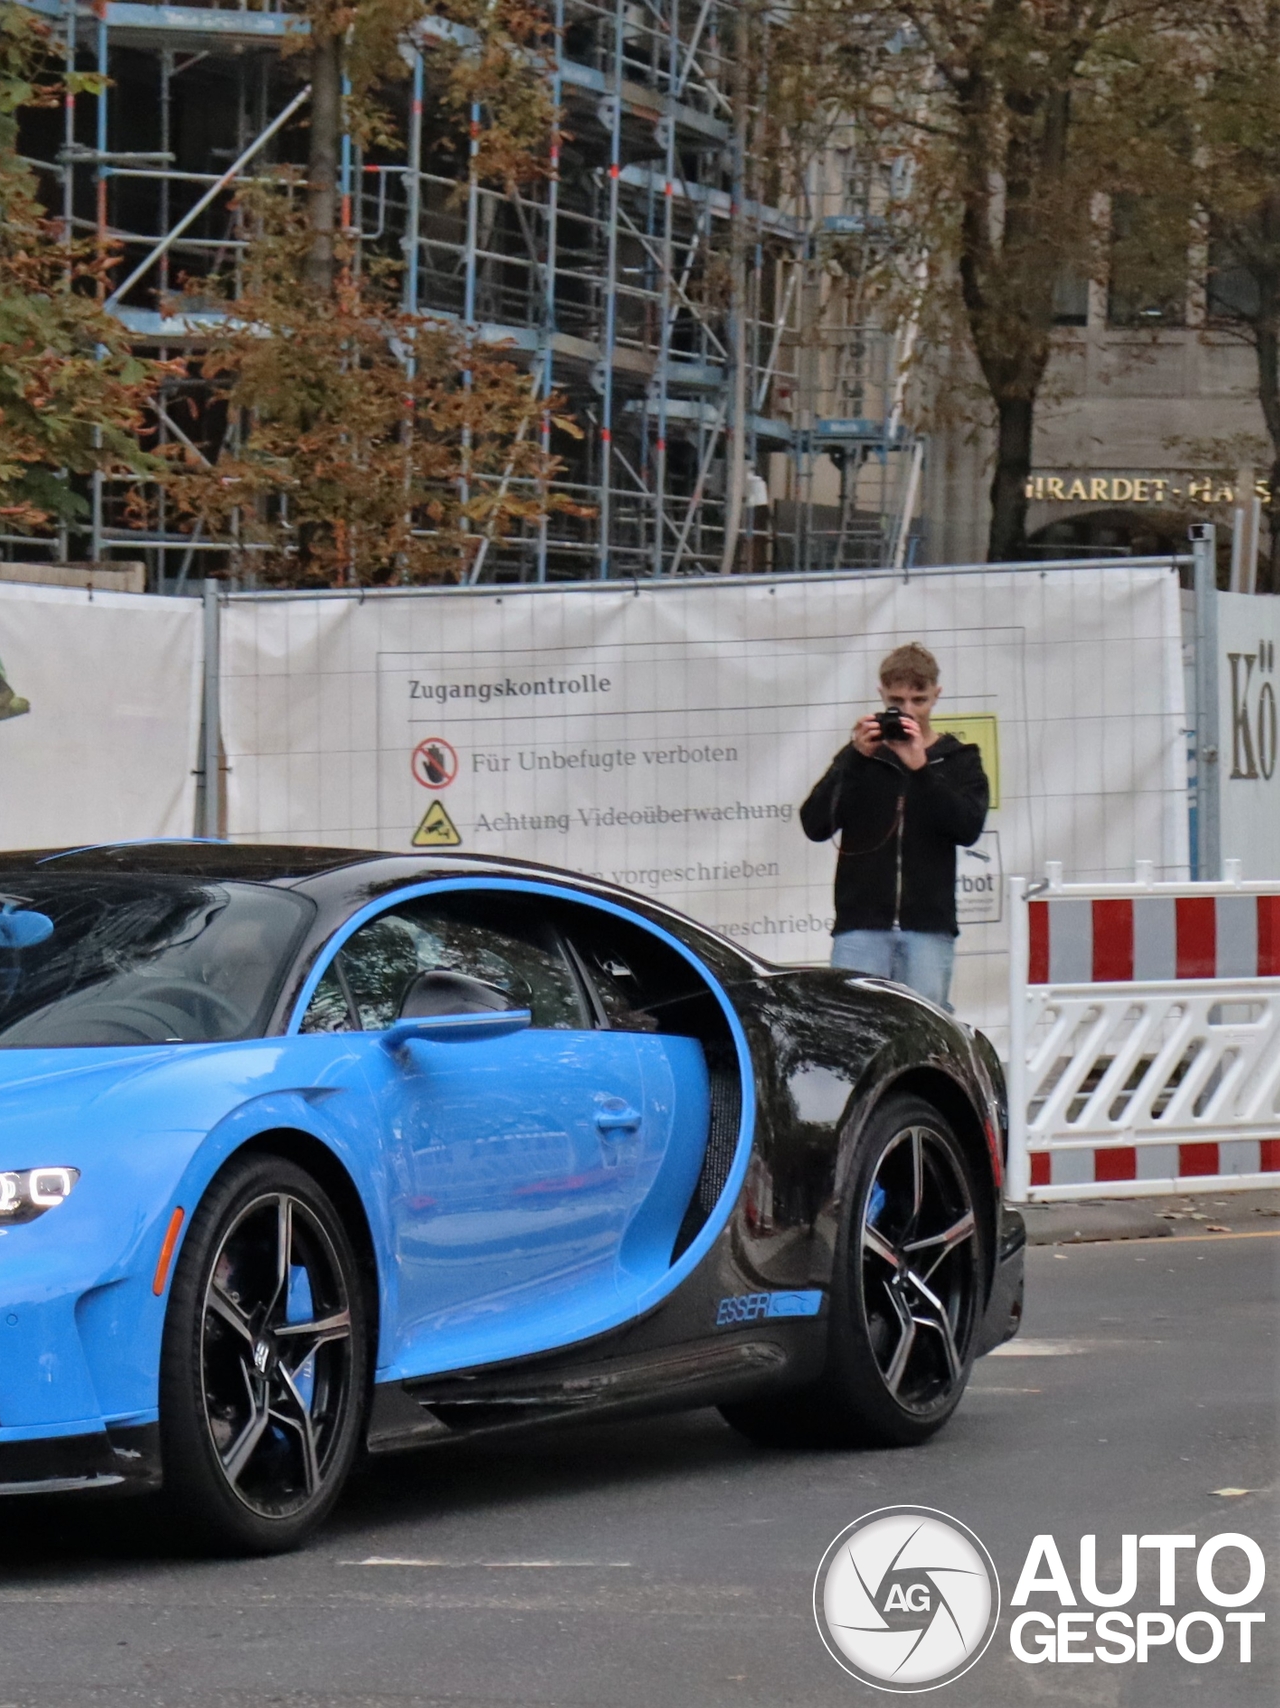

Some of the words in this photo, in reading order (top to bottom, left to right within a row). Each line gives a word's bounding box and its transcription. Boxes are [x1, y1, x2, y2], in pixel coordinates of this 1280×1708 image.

[407, 674, 612, 703] Zugangskontrolle
[472, 753, 511, 773] Für
[518, 748, 637, 773] Unbefugte
[643, 745, 739, 765] verboten
[474, 812, 571, 834] Achtung
[577, 801, 793, 828] Videoüberwachung
[611, 859, 780, 888] vorgeschrieben
